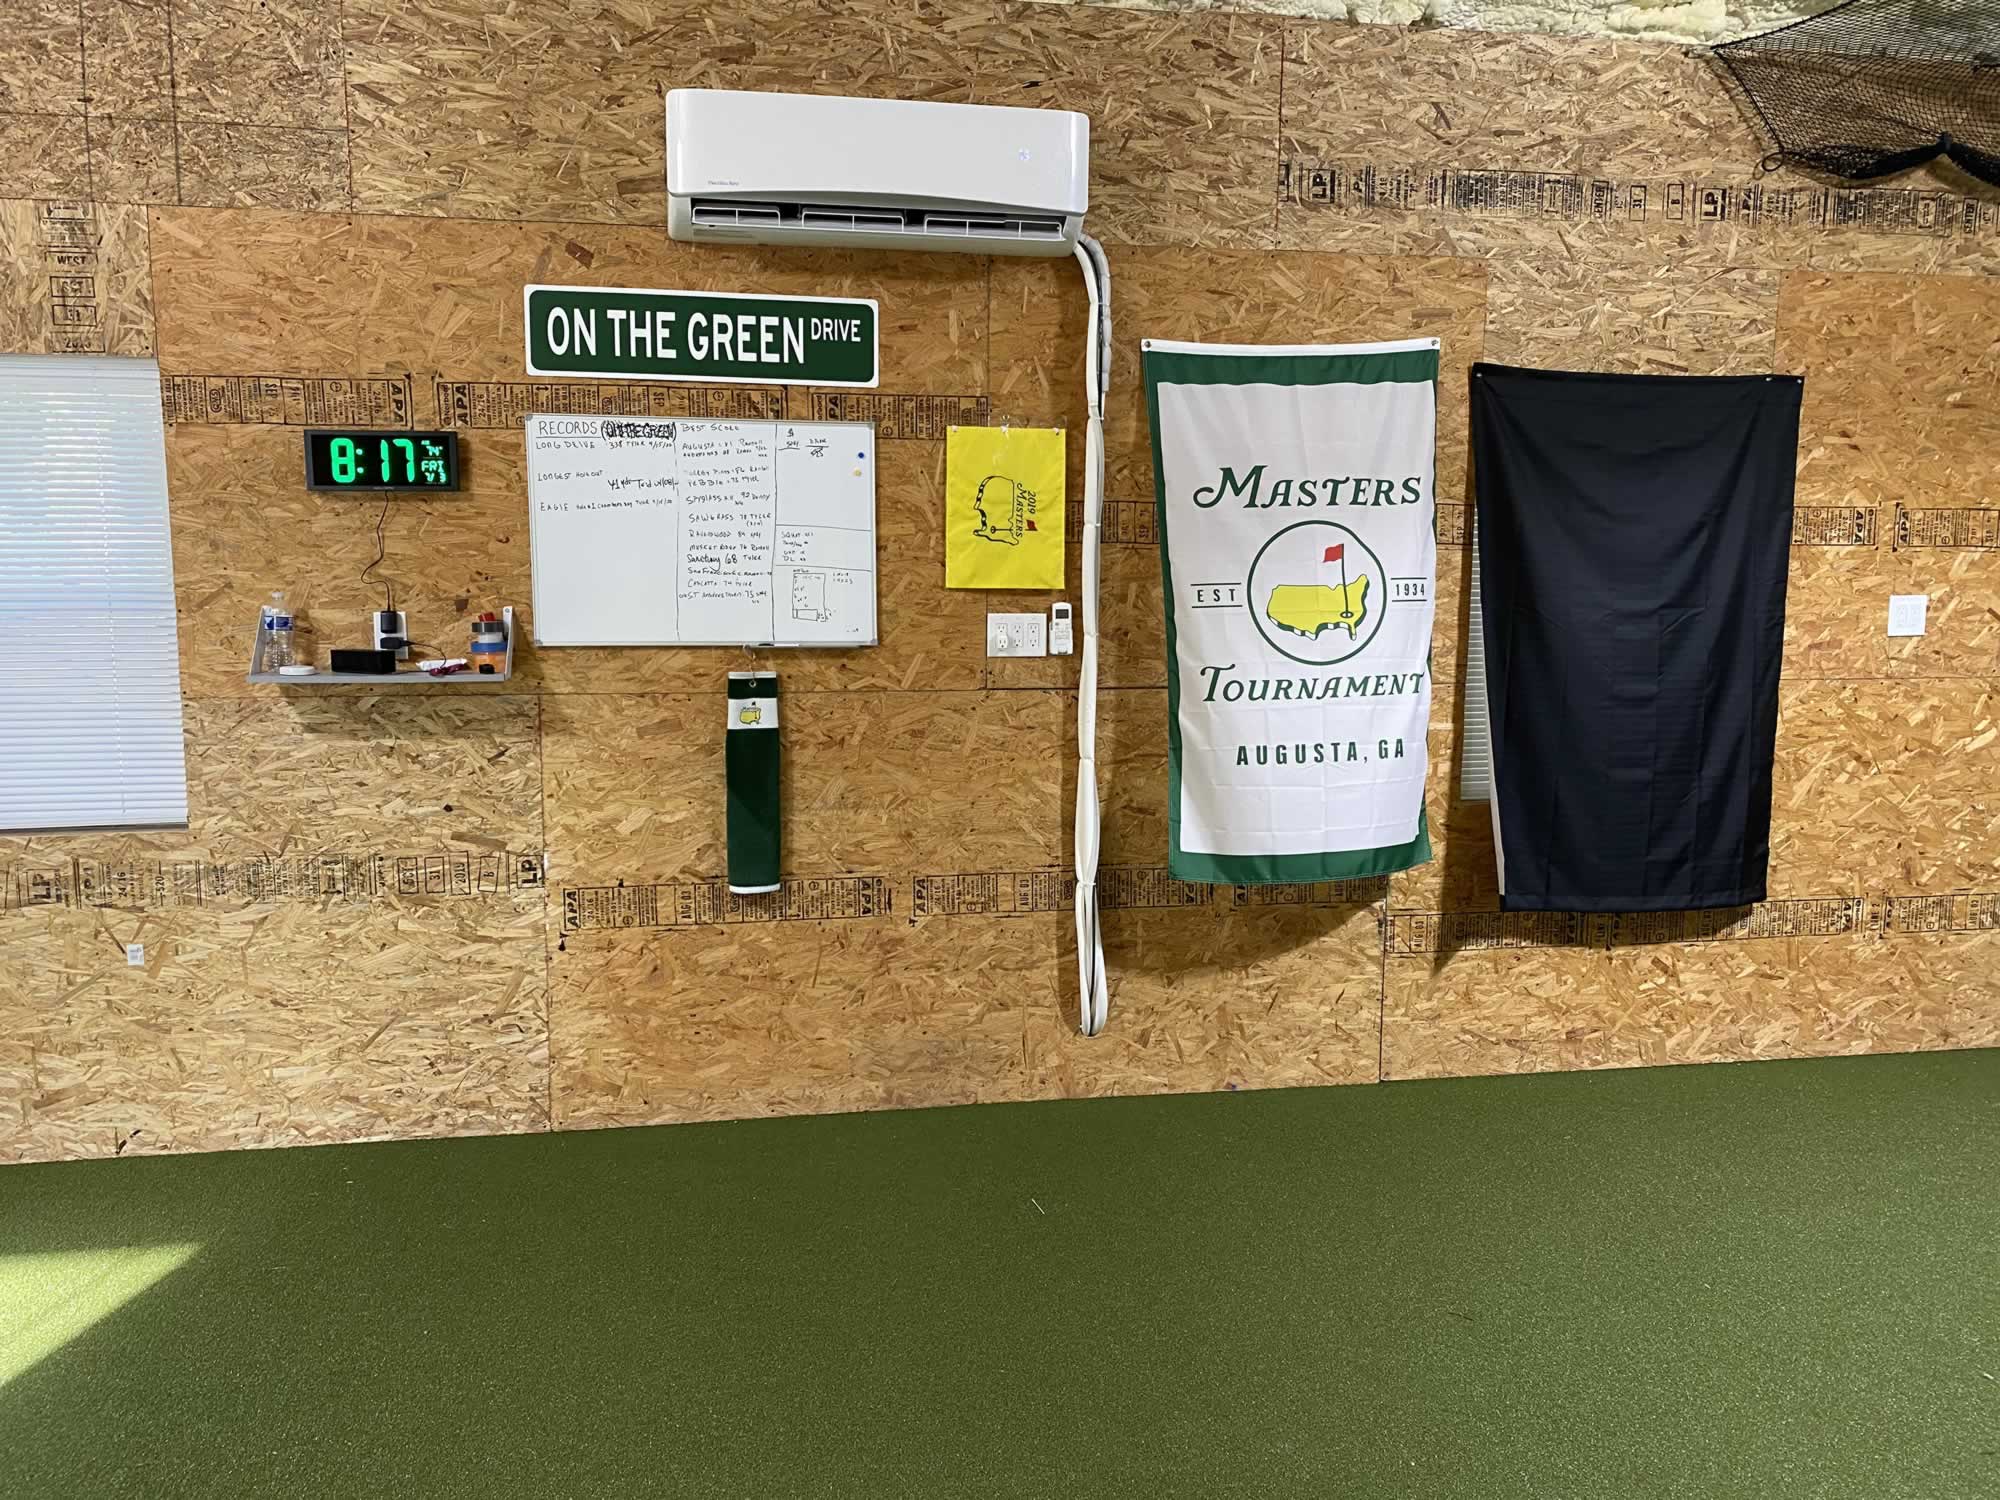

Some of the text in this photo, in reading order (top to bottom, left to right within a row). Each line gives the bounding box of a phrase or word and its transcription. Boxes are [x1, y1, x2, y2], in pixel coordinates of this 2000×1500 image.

[547, 306, 861, 364] ON THE GREEN DRIVE
[391, 383, 405, 422] APA
[455, 385, 469, 425] APA
[478, 394, 486, 418] 24/16
[828, 395, 840, 420] PA
[538, 421, 598, 436] RECORDS
[536, 441, 561, 449] LONG
[564, 440, 595, 448] DRIVE
[330, 437, 415, 484] 8:17
[421, 460, 445, 473] FRI
[537, 472, 571, 481] LONGEST
[1193, 465, 1421, 509] MASTERS
[540, 503, 568, 511] EAGLE
[1016, 483, 1027, 538] MASTERS
[1027, 490, 1037, 514] 2019
[1854, 510, 1864, 543] APA
[1900, 510, 1910, 544] APA
[725, 553, 738, 564] 68
[1197, 589, 1236, 603] EST
[1396, 583, 1425, 597] 1934
[1200, 664, 1425, 702] TOURNAMENT
[1236, 738, 1404, 765] AUGUSTA, GA
[430, 867, 440, 880] 31
[861, 880, 872, 915] APA
[916, 878, 927, 913] APA
[1020, 879, 1030, 906] AUG 03
[568, 890, 579, 928] APA
[1414, 934, 1424, 948] AUG
